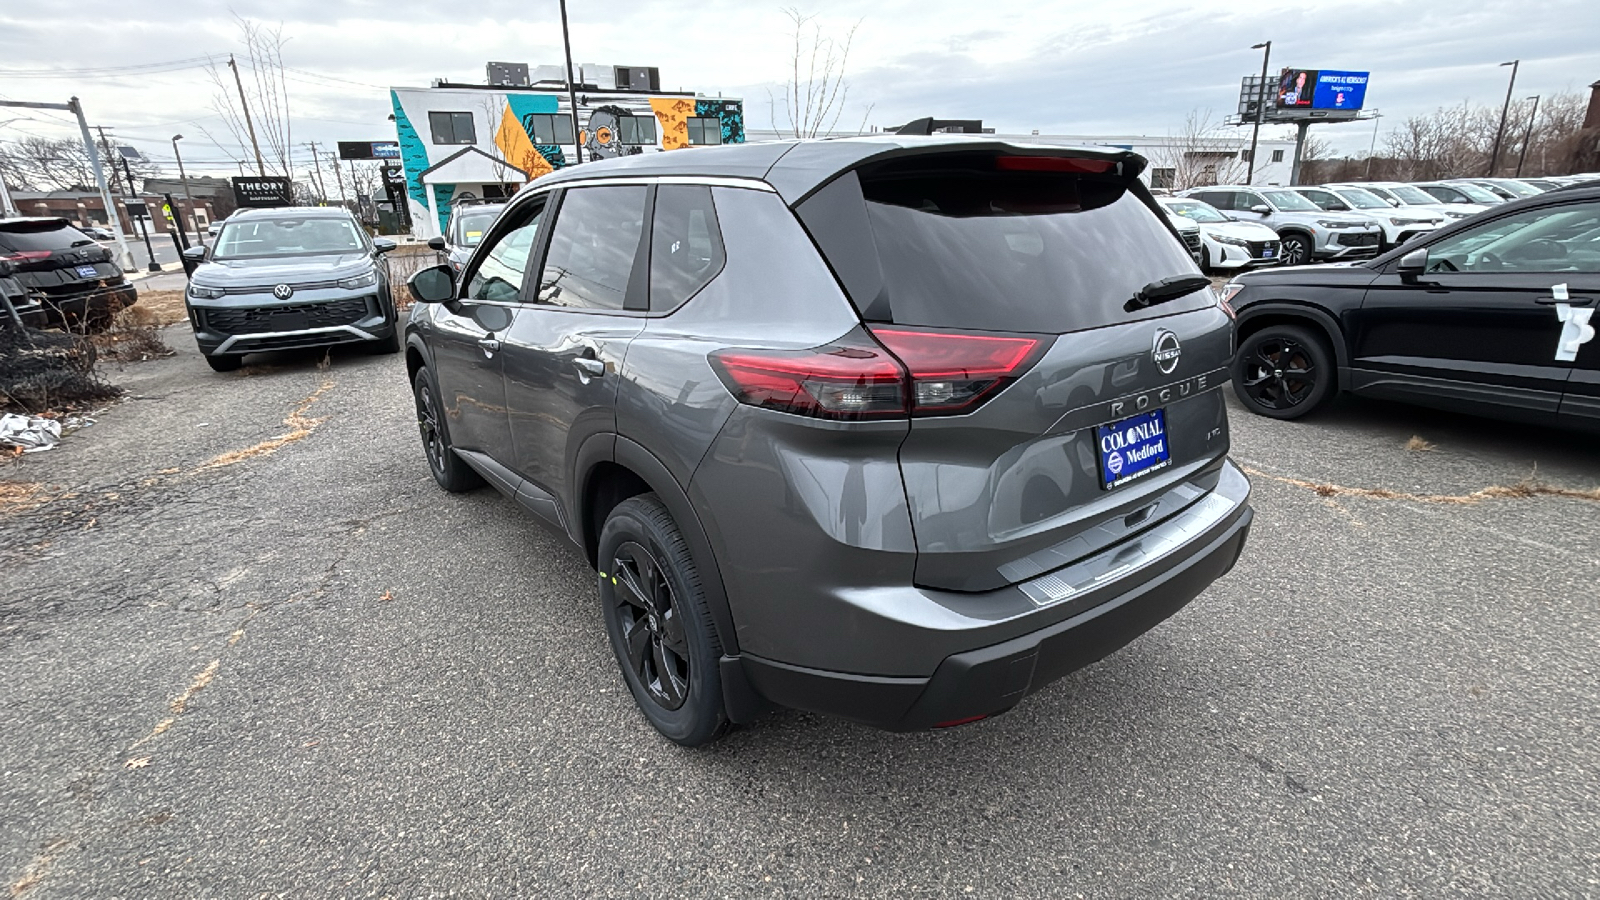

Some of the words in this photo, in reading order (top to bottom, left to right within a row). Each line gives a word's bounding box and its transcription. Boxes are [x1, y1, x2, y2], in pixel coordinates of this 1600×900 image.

[238, 182, 284, 191] THEORY
[1154, 350, 1181, 362] NISSAN
[1110, 375, 1207, 418] ROGUE
[1101, 419, 1163, 453] COLONIAL
[1126, 439, 1164, 465] Medford
